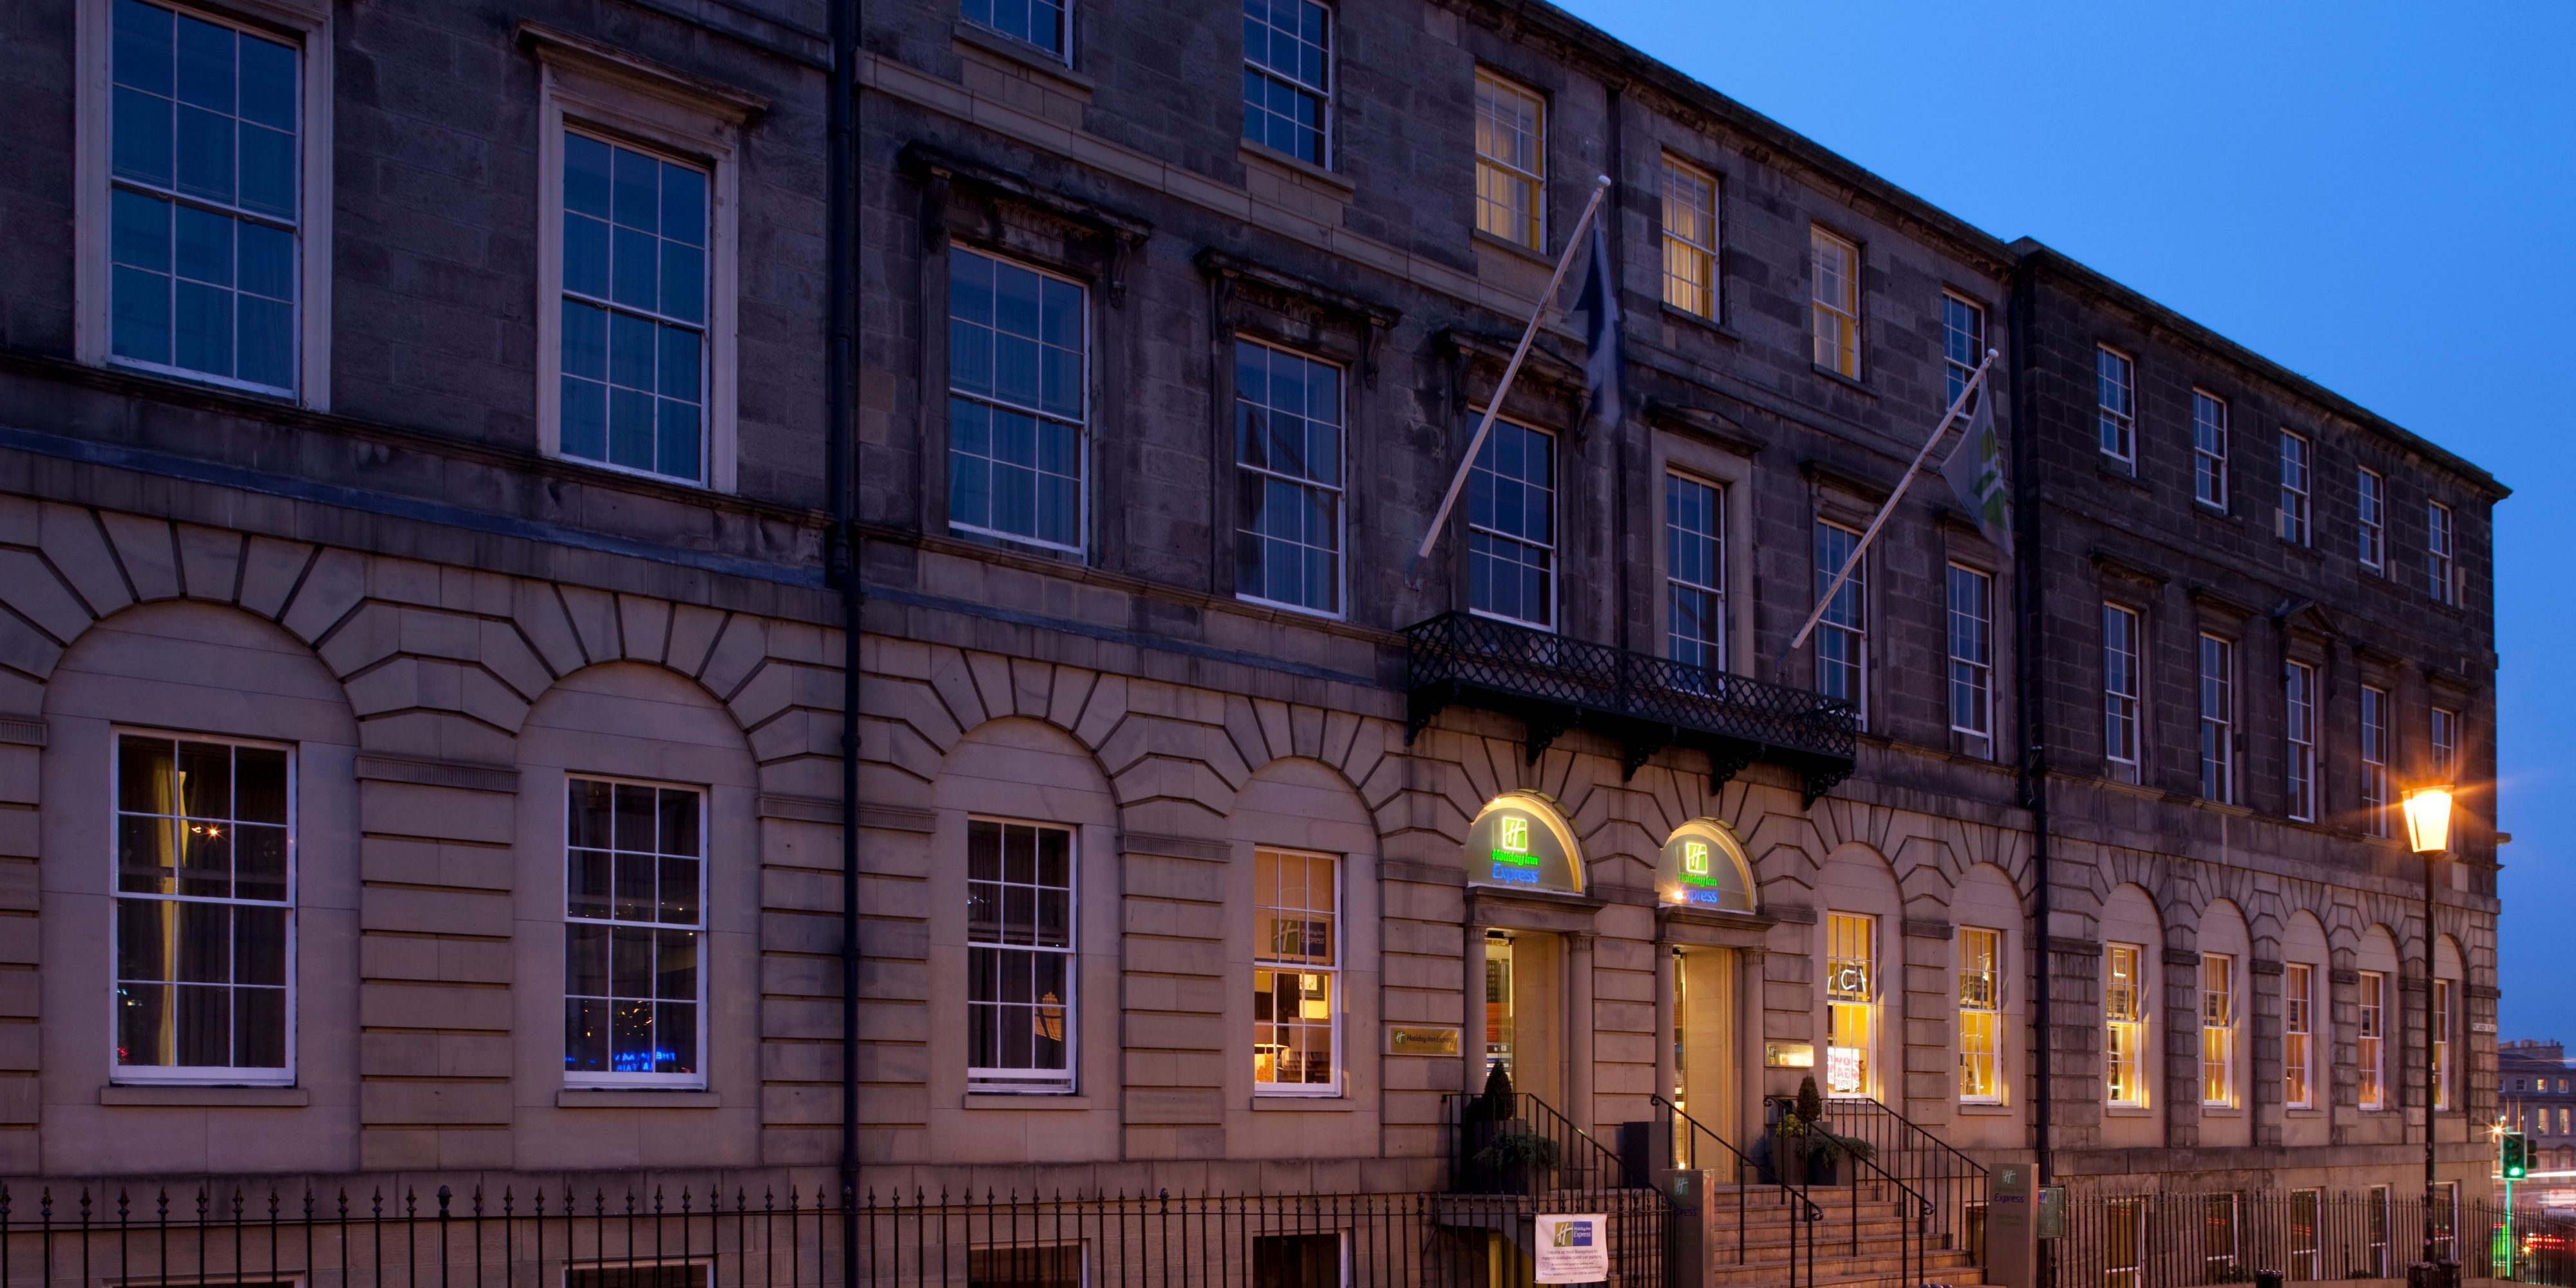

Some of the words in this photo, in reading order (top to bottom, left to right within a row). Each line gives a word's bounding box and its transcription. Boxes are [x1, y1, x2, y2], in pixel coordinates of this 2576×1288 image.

[1492, 848, 1524, 866] Holiday
[1524, 852, 1539, 866] Inn
[1492, 862, 1539, 884] Express
[1678, 872, 1706, 887] Holiday
[1705, 875, 1718, 887] Inn
[1406, 1034, 1427, 1043] Holiday
[1994, 1193, 2024, 1204] Express
